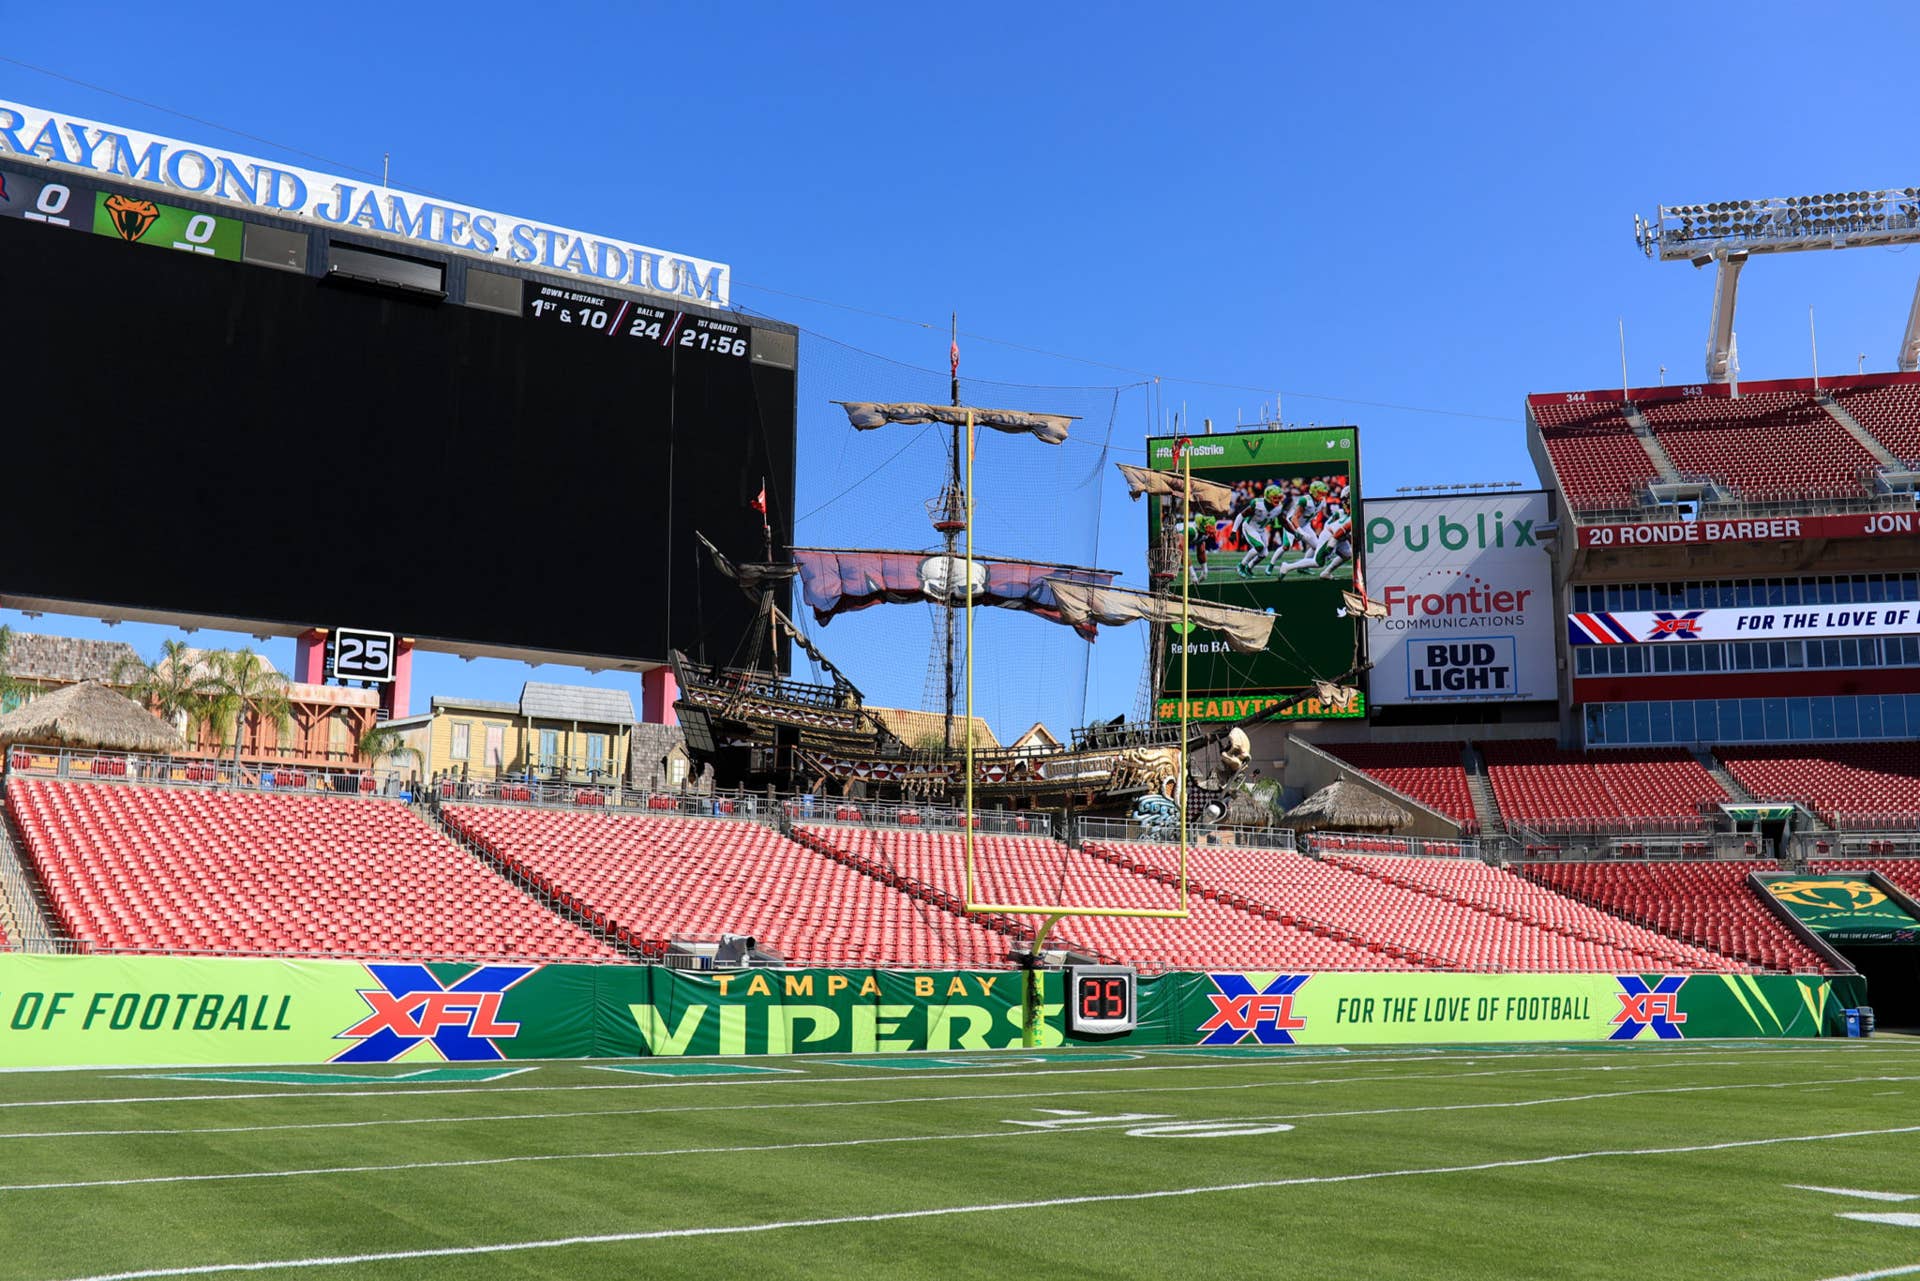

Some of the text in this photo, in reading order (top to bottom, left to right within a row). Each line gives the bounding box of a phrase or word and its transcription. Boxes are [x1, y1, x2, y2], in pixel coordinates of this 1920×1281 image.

[0, 107, 725, 305] RAYMOND JAMES STADIUM
[37, 184, 70, 214] 0
[185, 215, 216, 244] 0
[541, 287, 563, 297] DOWN
[571, 293, 605, 306] DISTANCE
[531, 299, 608, 329] 1ST & 10
[636, 307, 653, 317] BALL
[629, 319, 661, 340] 24
[709, 321, 738, 334] QUARTER
[679, 329, 747, 357] 21:56
[1566, 394, 1586, 402] 344
[1683, 387, 1702, 396] 343
[1156, 444, 1224, 458] #RedToStrike
[1366, 511, 1536, 553] Publix
[1589, 519, 1800, 545] 20 RONDÉ BARBER
[1864, 514, 1911, 534] JON
[1384, 584, 1531, 617] Frontier
[1385, 615, 1525, 630] COMMUNICATIONS
[1648, 619, 1703, 633] XFL
[1737, 615, 1775, 630] FOR
[1783, 613, 1819, 629] THE
[1826, 611, 1877, 627] LOVE
[1884, 610, 1910, 625] OF
[339, 638, 388, 671] 25
[1171, 643, 1198, 655] Redy
[1200, 643, 1208, 652] to
[1427, 644, 1495, 667] BUD
[1414, 667, 1509, 690] LIGHT
[1159, 696, 1360, 718] #READYTOSTRKE
[712, 973, 997, 997] TAMPA BAY
[1083, 981, 1122, 1016] 25
[1336, 996, 1590, 1023] FOR THE LOVE OF FOOTBALL
[1608, 992, 1687, 1025] XFL
[10, 992, 291, 1031] OF FOOTBALL
[332, 990, 520, 1038] XFL
[1197, 994, 1307, 1031] XFL
[628, 1003, 1065, 1056] VIPERS
